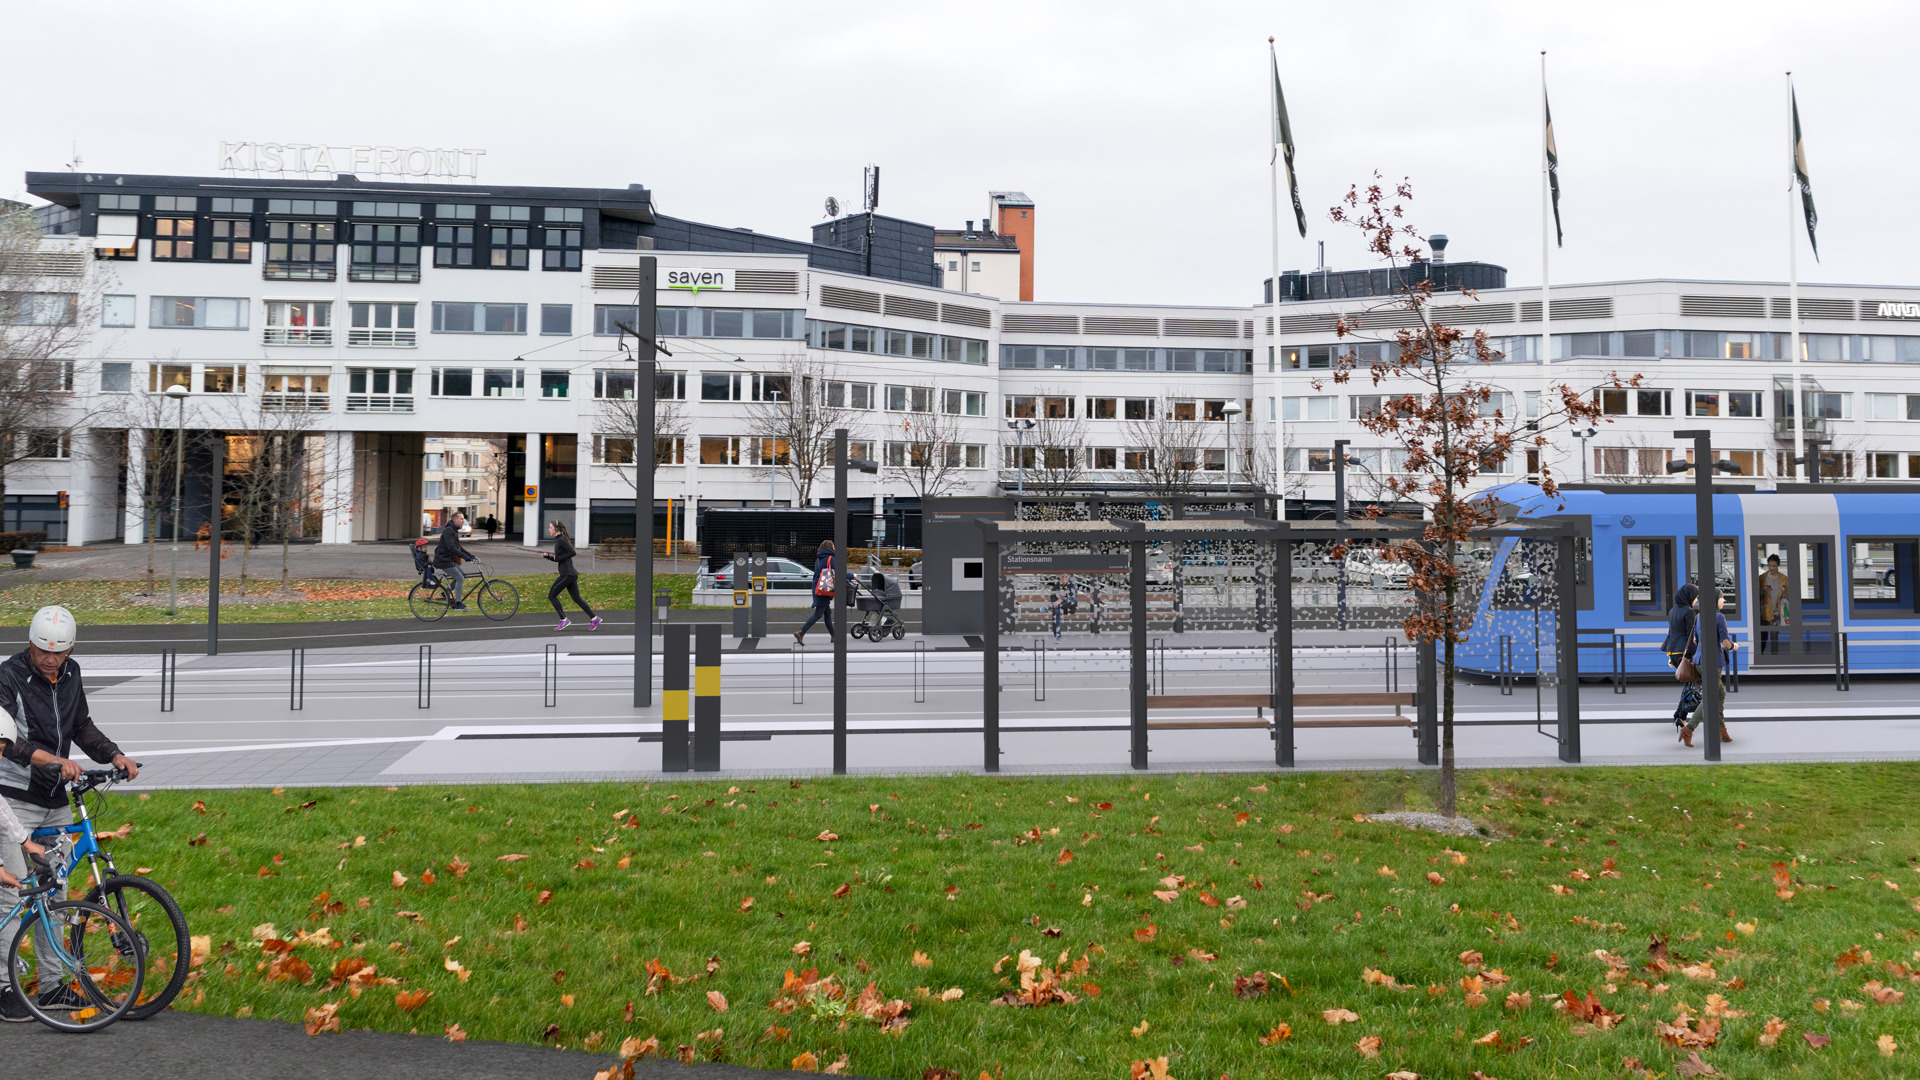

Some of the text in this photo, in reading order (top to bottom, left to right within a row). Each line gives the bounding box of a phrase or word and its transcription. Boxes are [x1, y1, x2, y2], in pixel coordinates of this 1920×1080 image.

[219, 141, 486, 178] KISTA FRONT
[668, 271, 723, 285] saven
[1007, 555, 1052, 563] Stationsnamn
